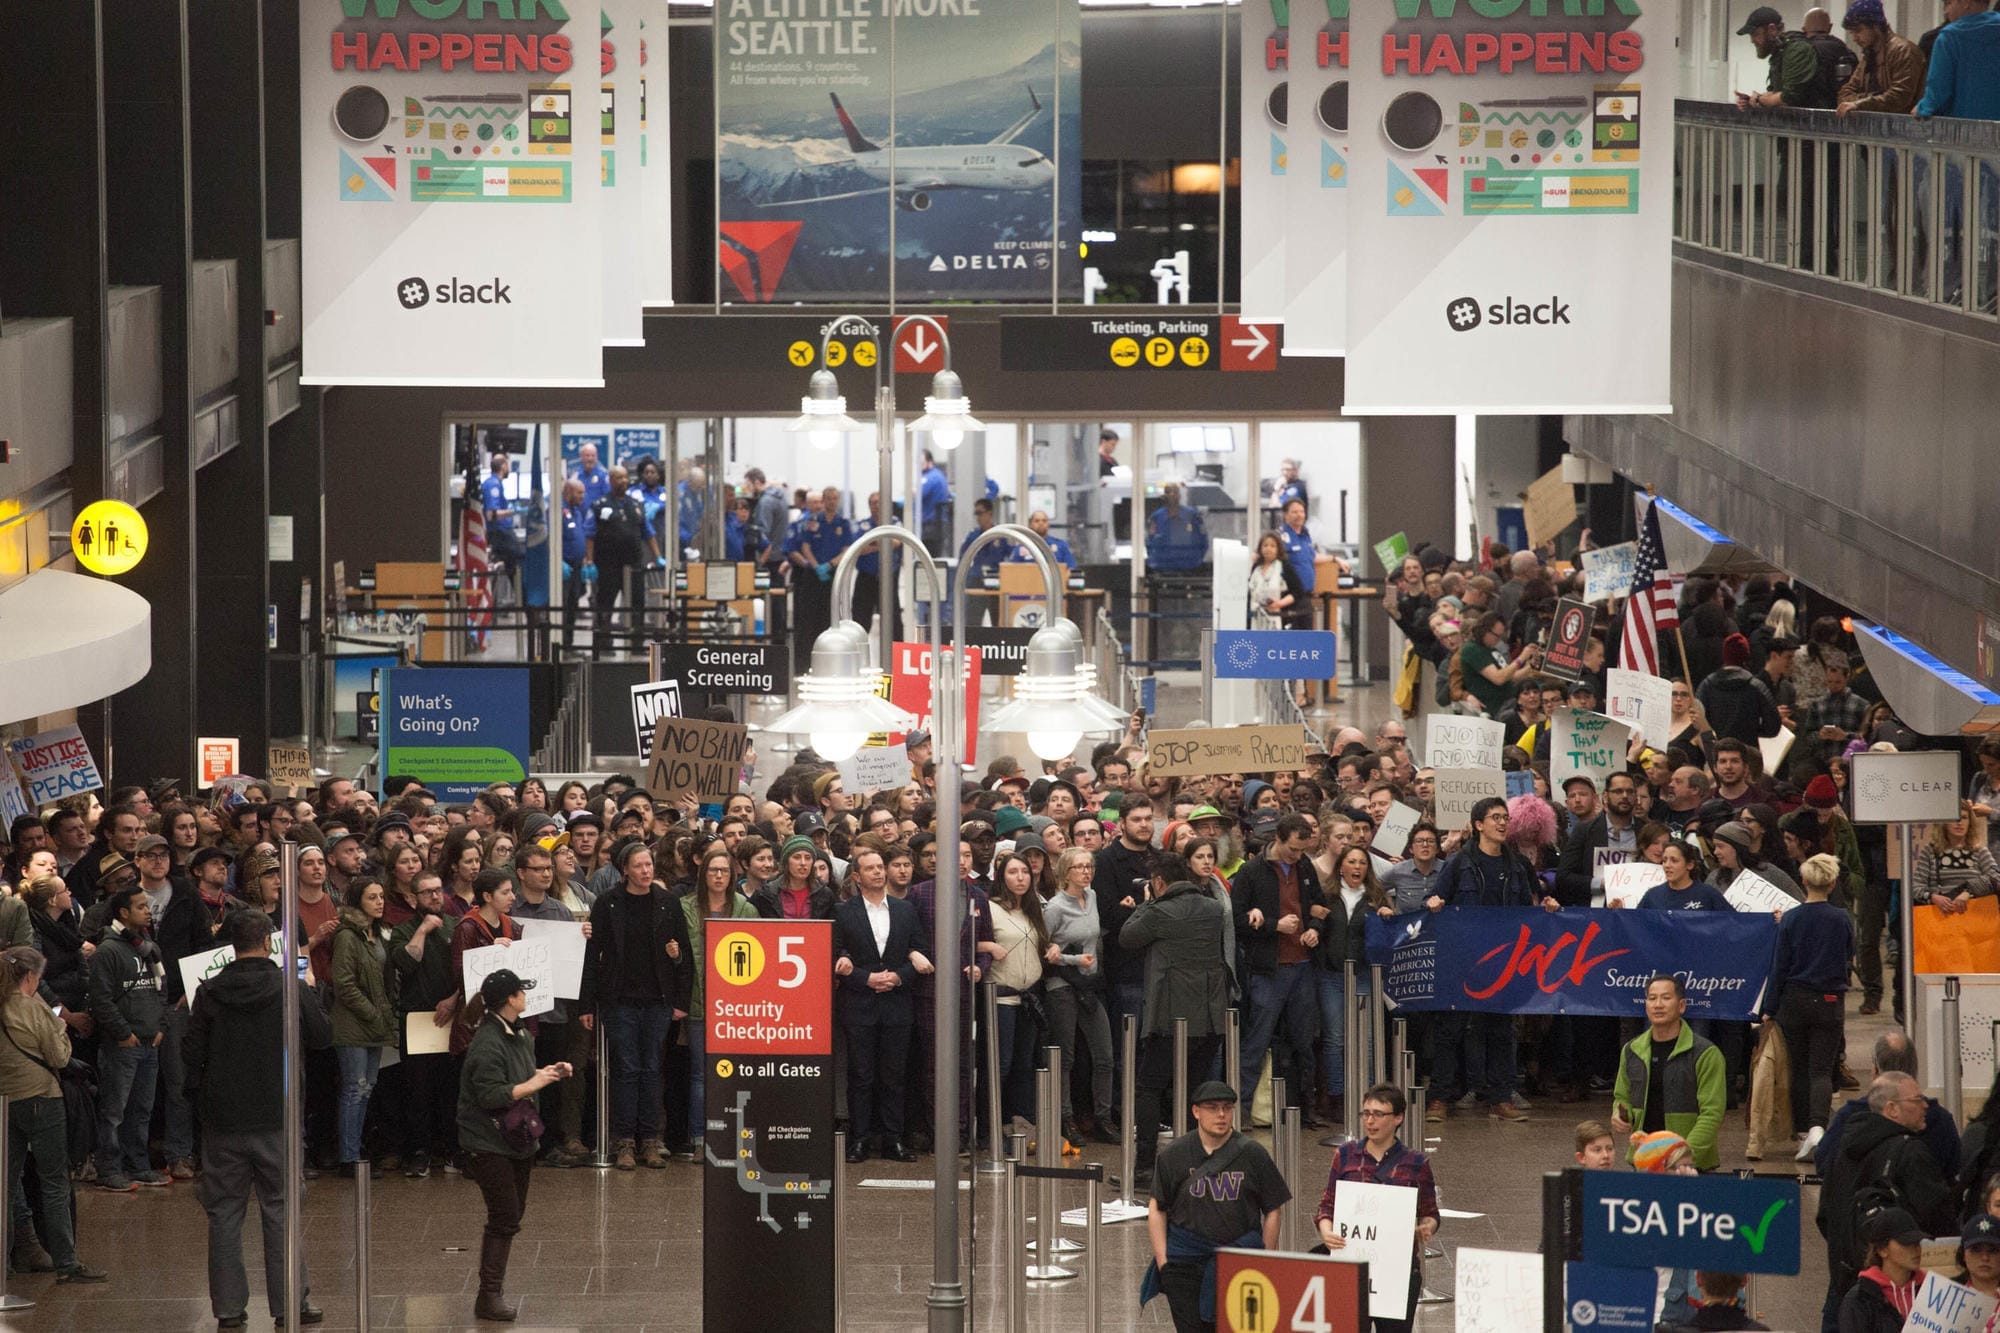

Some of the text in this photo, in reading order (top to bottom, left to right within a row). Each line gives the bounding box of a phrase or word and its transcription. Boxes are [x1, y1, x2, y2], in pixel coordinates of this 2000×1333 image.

[728, 21, 877, 55] SEATTLE.
[332, 32, 573, 73] HAPPENS
[1382, 31, 1645, 76] HAPPENS
[993, 241, 1067, 250] KEEP CLIMBIG
[953, 255, 1028, 270] DELTA
[435, 278, 512, 304] slack
[1488, 296, 1571, 325] slack
[1092, 321, 1209, 337] Ticketing, Parking
[697, 648, 765, 666] General
[902, 649, 972, 679] LOE
[1267, 650, 1320, 660] CLEAR
[687, 670, 773, 691] Screening
[400, 694, 453, 710] What's
[400, 717, 480, 735] Going On?
[661, 725, 699, 753] NO
[700, 727, 747, 761] BAN
[1153, 741, 1200, 768] STOP
[1250, 735, 1305, 764] RACISM
[22, 736, 88, 771] JUSTICE
[1567, 749, 1615, 769] THIS!
[652, 757, 692, 791] NO
[31, 766, 100, 802] PEACE
[1440, 780, 1497, 795] REFUGEES
[1900, 781, 1952, 793] CLEAR
[810, 815, 817, 823] S
[1597, 850, 1632, 866] NOT
[778, 936, 807, 989] 5
[1392, 946, 1436, 964] JAPANESE
[1389, 958, 1436, 973] AMERICAN
[1388, 970, 1436, 985] CITIZENS
[1387, 983, 1435, 997] EAGUE
[714, 999, 784, 1022] Security
[714, 1021, 813, 1044] Checkpoint
[738, 1062, 821, 1078] to all Gates
[748, 1130, 754, 1139] 5
[777, 1126, 812, 1134] Checkpoints
[747, 1150, 752, 1158] 4
[755, 1171, 761, 1180] 3
[793, 1182, 799, 1191] 2
[808, 1182, 812, 1191] 1
[1600, 1198, 1668, 1236] TSA
[1678, 1202, 1736, 1241] Pre
[1340, 1222, 1378, 1241] BAN
[1291, 1276, 1332, 1333] 4
[1927, 1275, 1977, 1325] WTF
[1911, 1311, 1943, 1333] going
